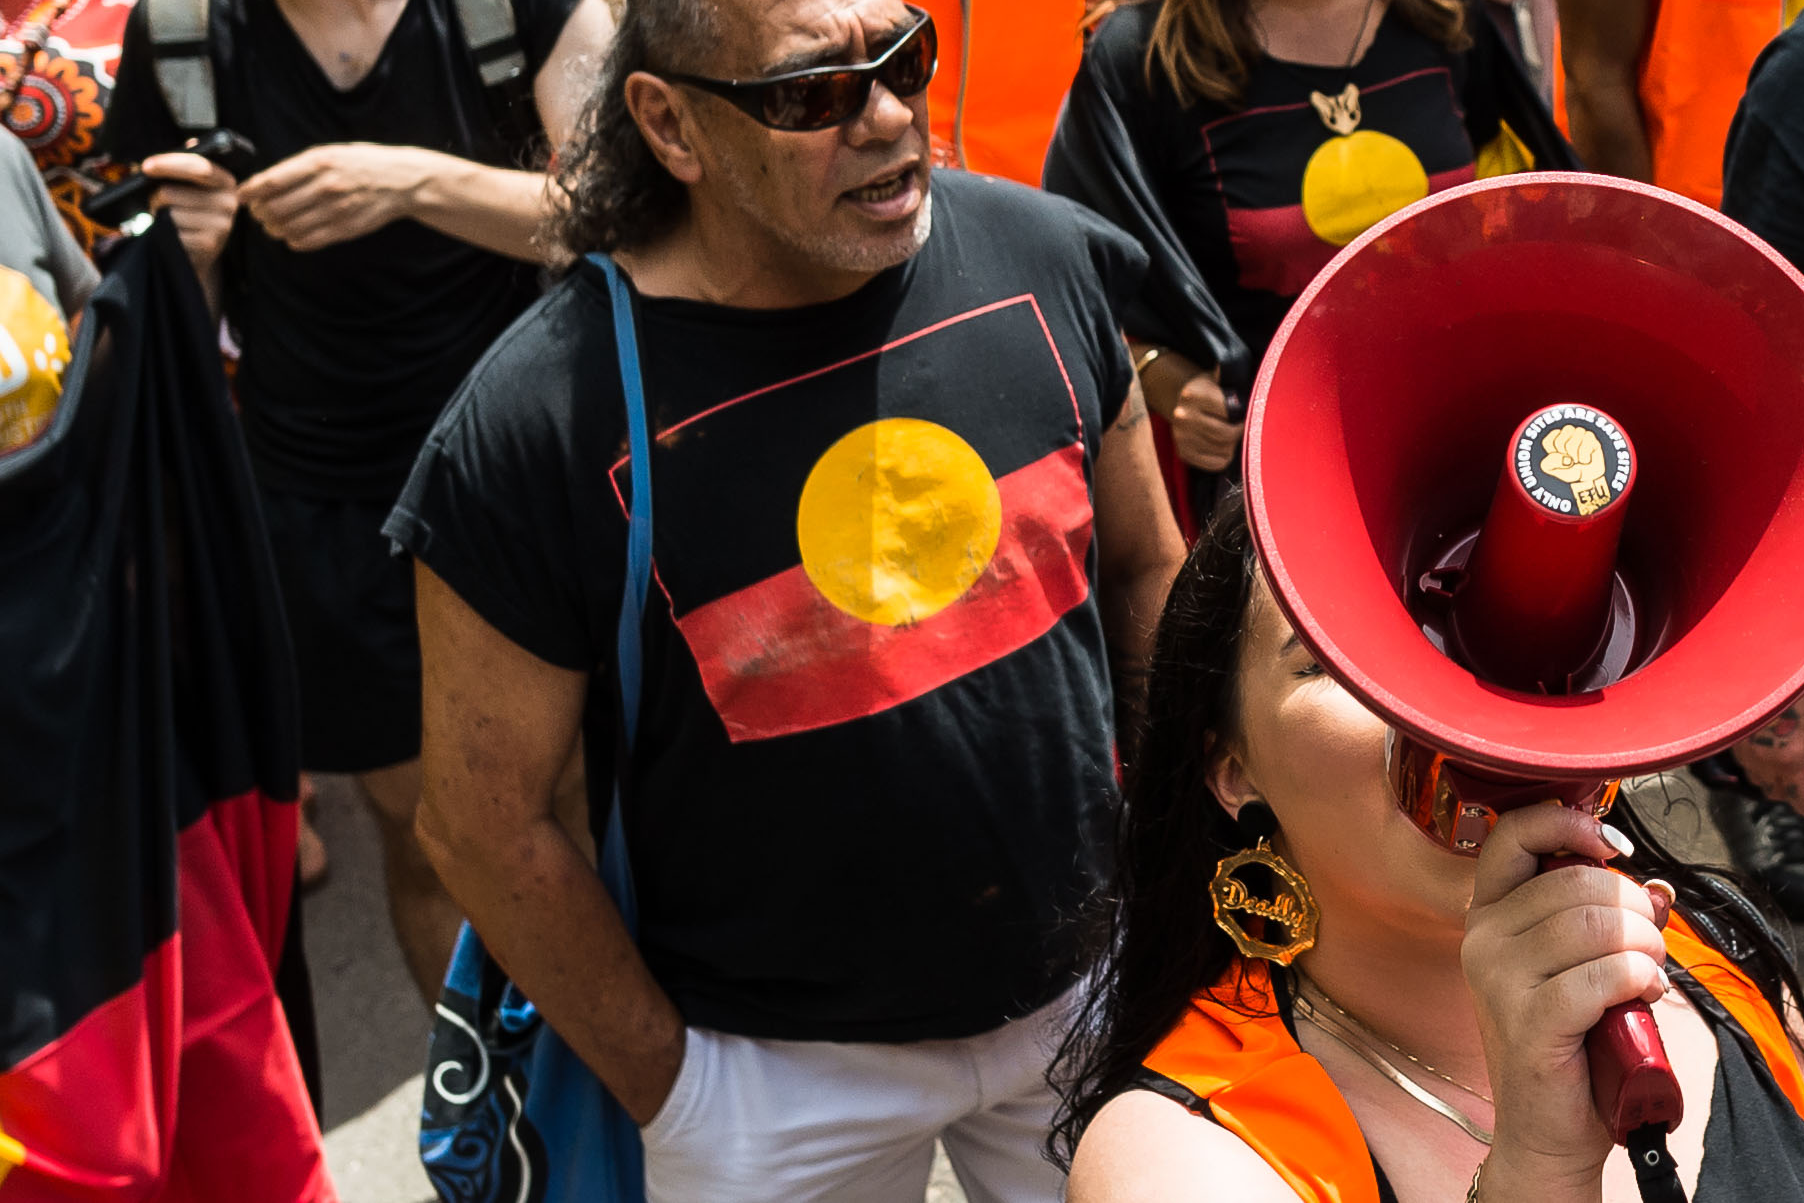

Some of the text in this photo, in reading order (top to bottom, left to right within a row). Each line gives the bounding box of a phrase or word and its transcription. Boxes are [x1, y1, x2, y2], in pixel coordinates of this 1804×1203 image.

[1518, 408, 1630, 512] ONLY UNION SITES ARE SAFE SITES
[1222, 878, 1306, 939] Deadly
